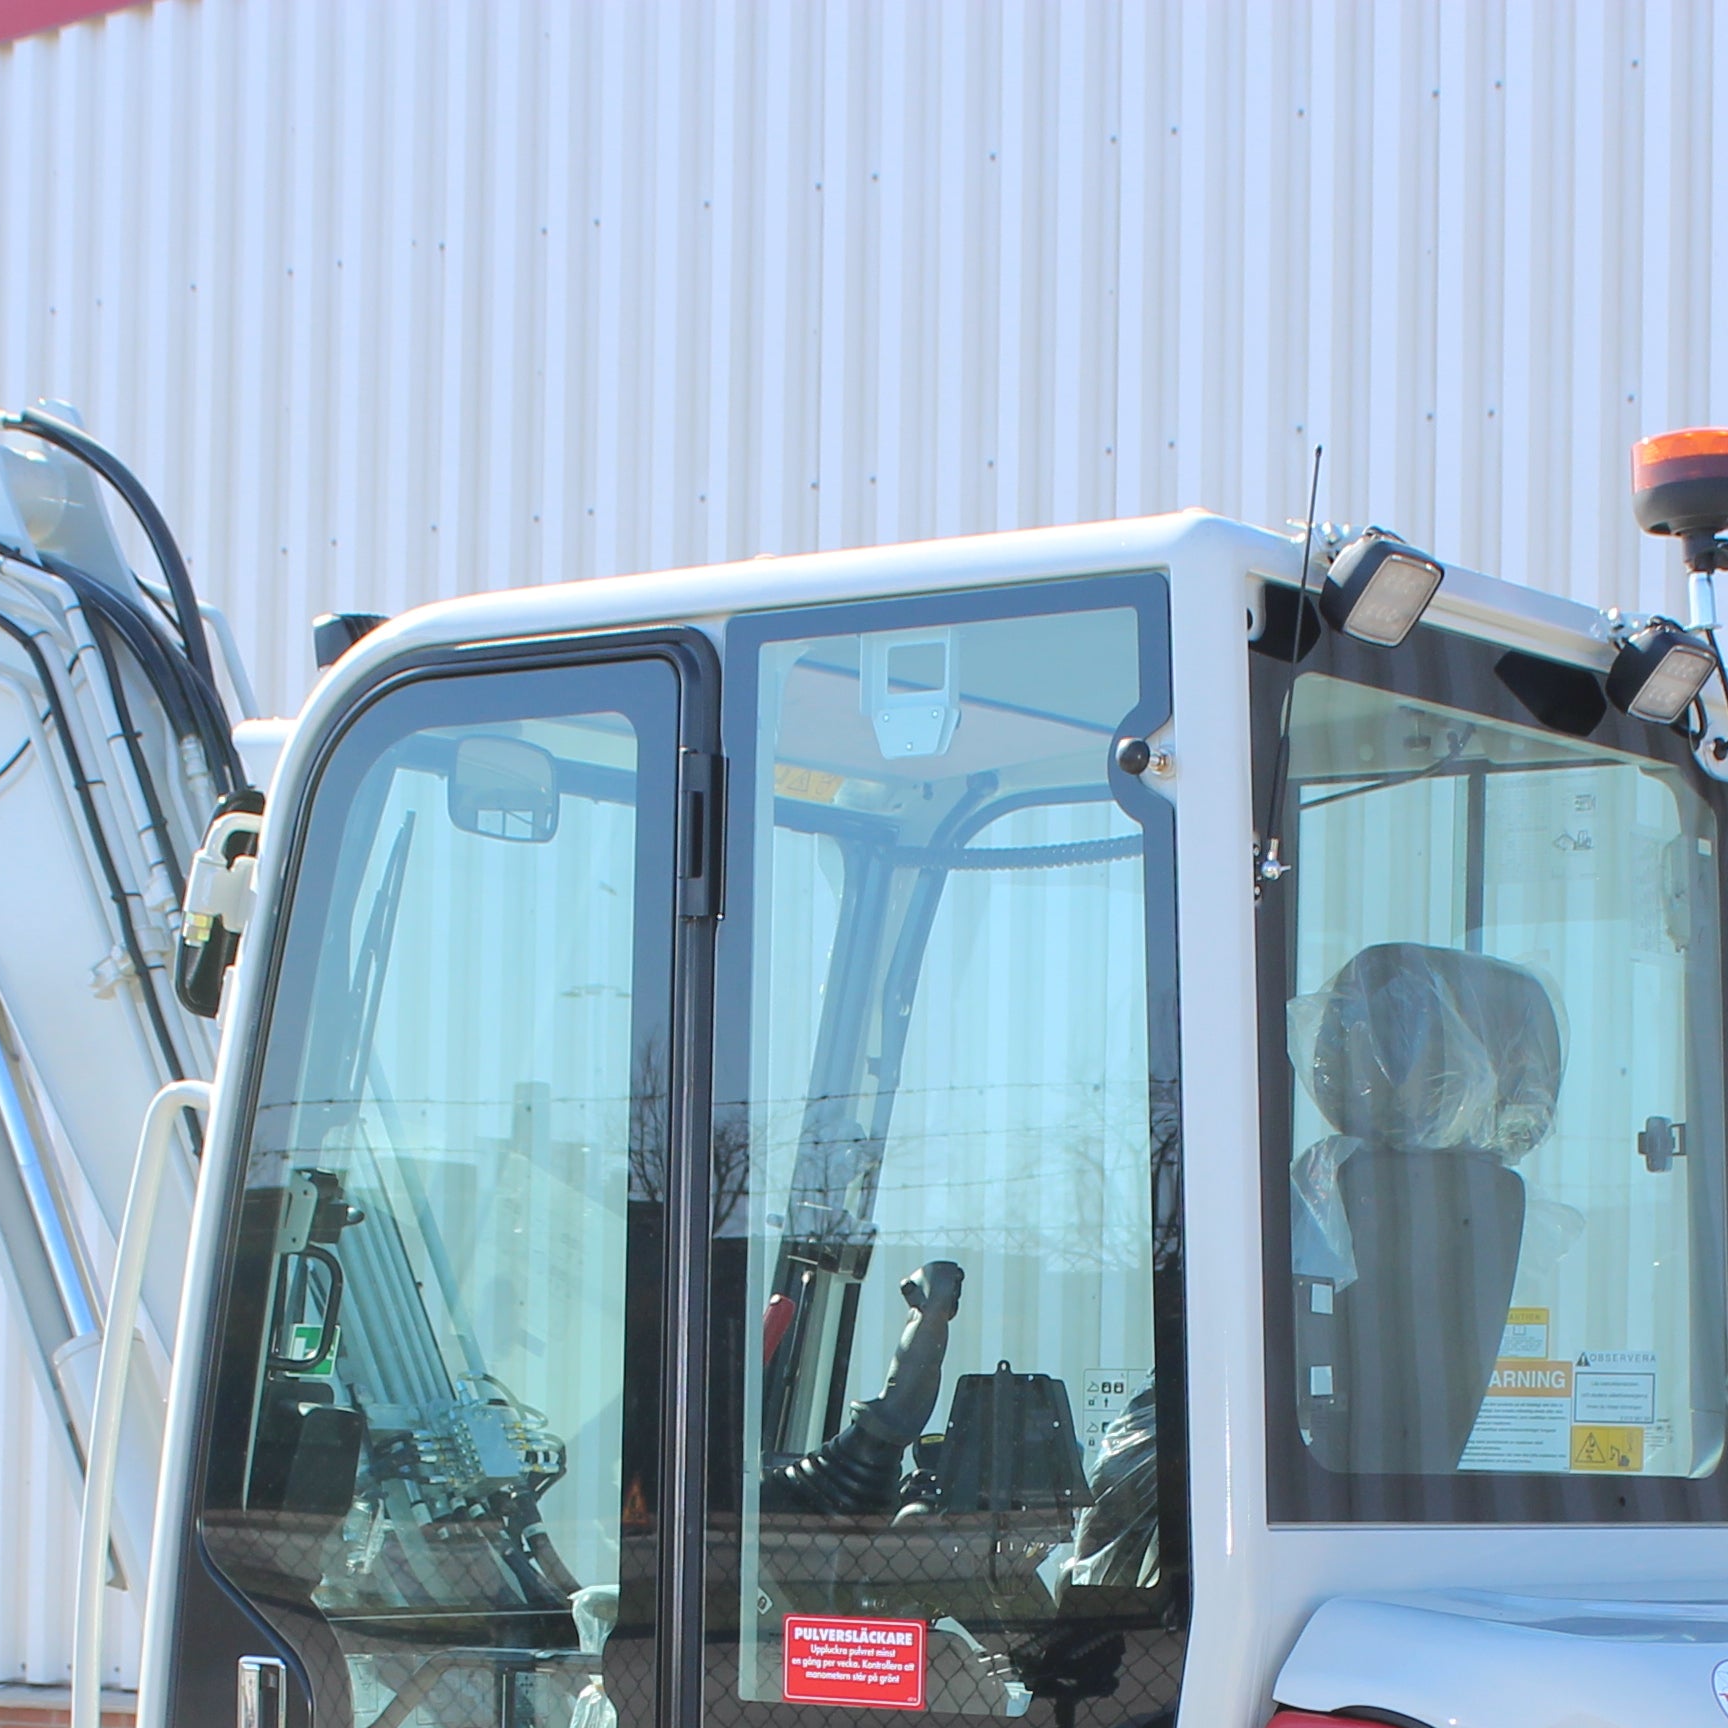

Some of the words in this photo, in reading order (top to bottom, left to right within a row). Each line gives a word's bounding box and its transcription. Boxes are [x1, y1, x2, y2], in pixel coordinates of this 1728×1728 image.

[1589, 1352, 1657, 1363] OBSERVERA
[1487, 1369, 1566, 1389] ARNING
[793, 1626, 914, 1646] PULVERSLÄCKARE
